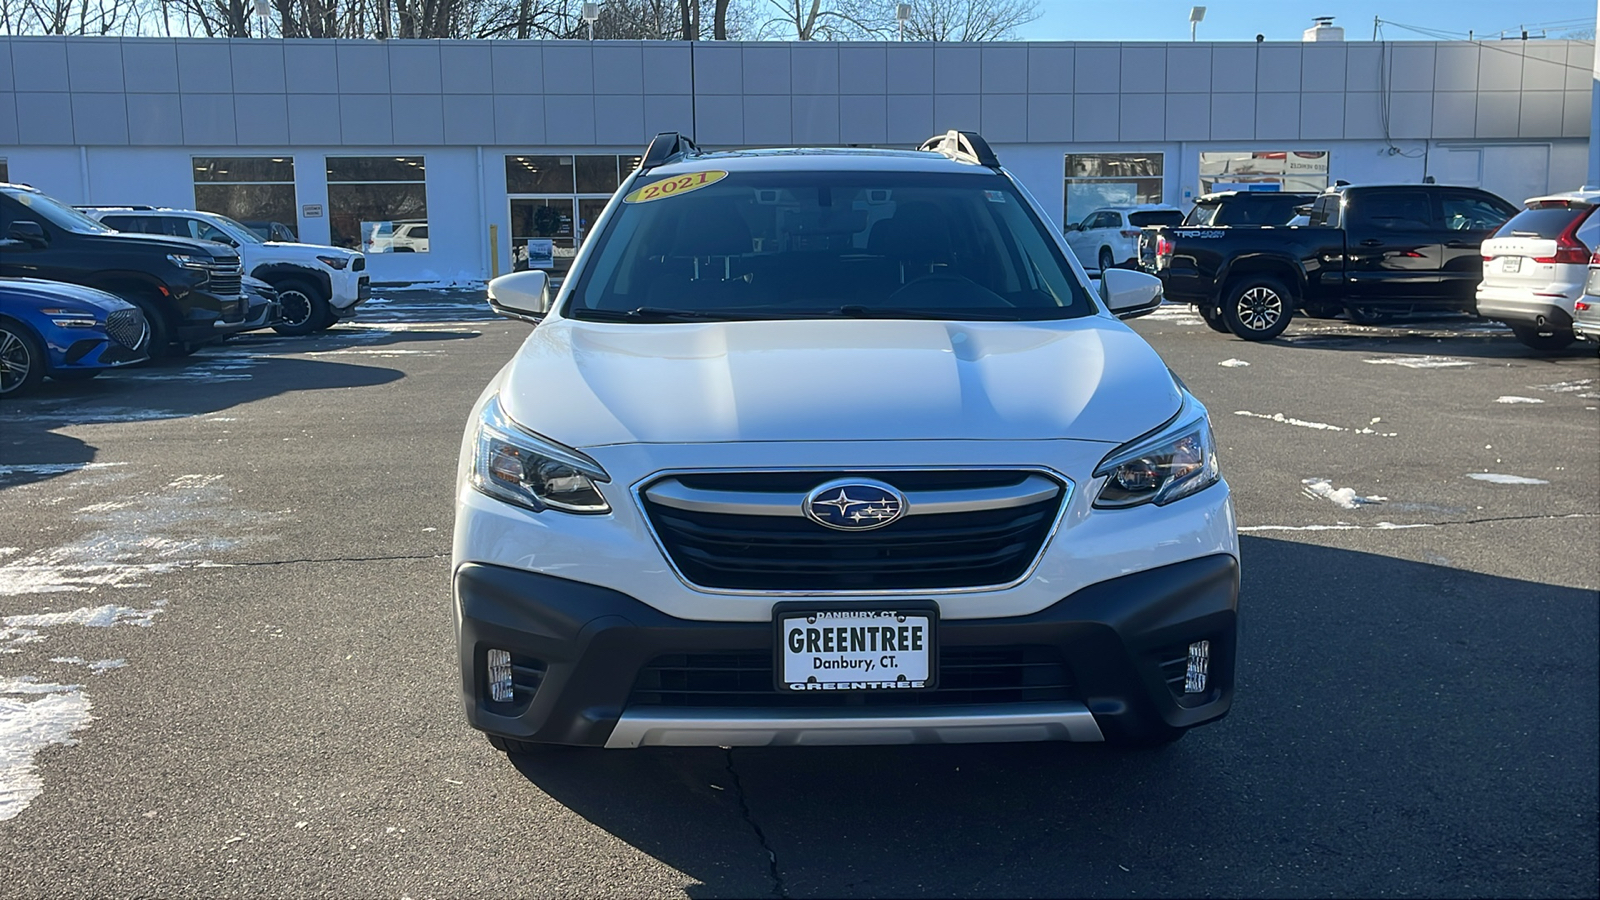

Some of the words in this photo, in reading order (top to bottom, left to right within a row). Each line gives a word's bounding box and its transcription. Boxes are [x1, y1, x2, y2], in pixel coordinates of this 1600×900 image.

[644, 172, 709, 200] 2021
[1173, 230, 1200, 238] TRD
[788, 626, 923, 653] GREENTREE
[813, 655, 876, 672] Danbury,
[880, 655, 898, 668] CT.
[790, 681, 925, 690] GREENTREE
